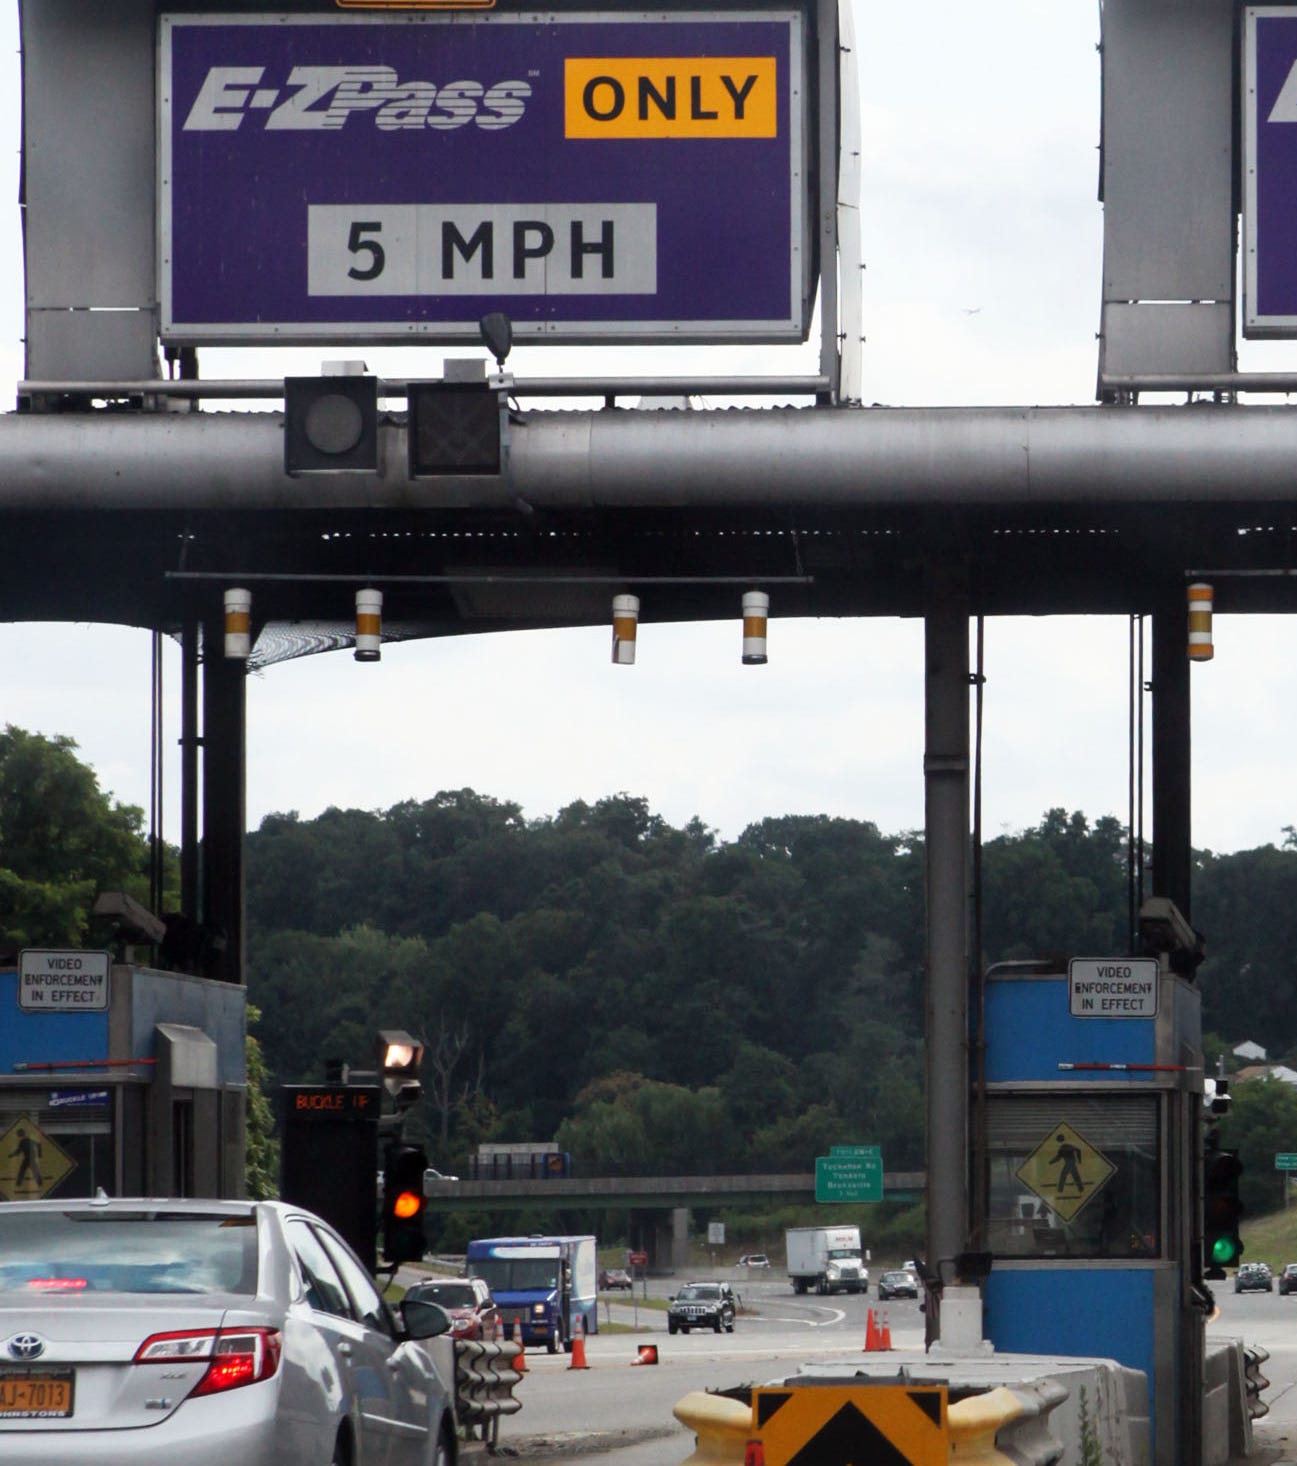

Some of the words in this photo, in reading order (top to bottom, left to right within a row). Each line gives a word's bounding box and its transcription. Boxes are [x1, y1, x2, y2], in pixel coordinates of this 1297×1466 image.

[583, 75, 759, 122] ONLY
[347, 221, 385, 281] 5
[442, 220, 614, 279] MPH
[47, 959, 82, 970] VIDEO
[1096, 966, 1132, 978] VIDEO
[24, 974, 104, 986] ENFORCEMENT
[1075, 982, 1152, 994] ENFORCEMENT
[32, 991, 43, 1001] IN
[51, 990, 96, 1002] EFFECT
[1082, 998, 1093, 1010] IN
[1101, 998, 1144, 1010] EFFECT
[296, 1094, 345, 1110] BUCKLE
